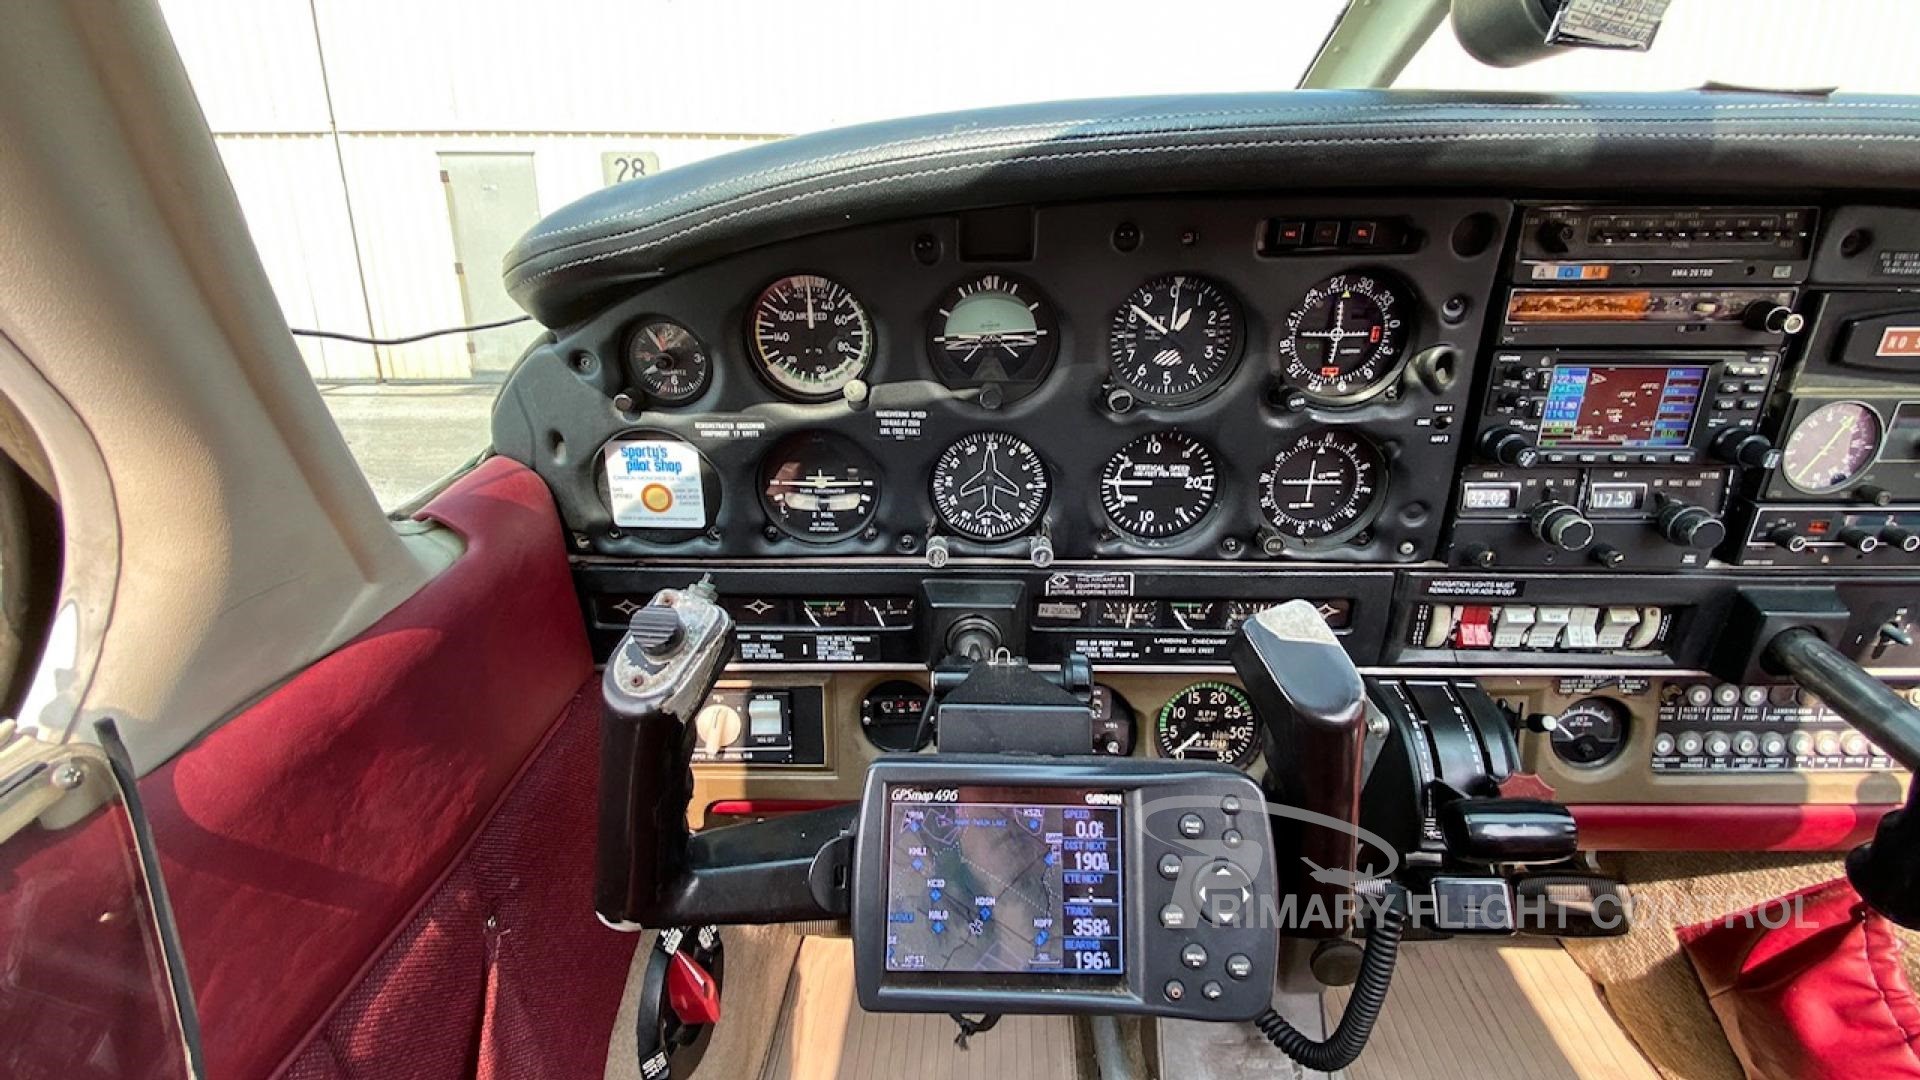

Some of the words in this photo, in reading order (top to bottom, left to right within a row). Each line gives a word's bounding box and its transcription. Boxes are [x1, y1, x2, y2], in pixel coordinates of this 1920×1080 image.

[1330, 275, 1347, 290] 27
[1358, 277, 1374, 291] 30
[820, 301, 835, 311] 40
[1143, 292, 1154, 307] 9
[779, 311, 795, 321] 160
[795, 311, 828, 321] AIREED
[834, 313, 849, 326] 60
[1128, 310, 1138, 324] 8
[1207, 310, 1218, 325] 2
[773, 331, 790, 343] 140
[1887, 335, 1908, 349] NO
[694, 352, 703, 364] 3
[1126, 349, 1136, 362] 7
[1204, 345, 1214, 360] 3
[1137, 363, 1147, 377] 6
[1187, 362, 1198, 376] 4
[670, 374, 679, 385] 6
[1162, 370, 1172, 385] 5
[620, 444, 668, 461] sporty's
[1145, 441, 1162, 455] 10
[626, 460, 651, 475] pilot
[654, 460, 683, 476] shop
[1134, 463, 1165, 472] VERTICAL
[1183, 476, 1203, 489] 20
[1139, 510, 1155, 523] 10
[1431, 580, 1471, 588] NAVIGATION
[1471, 581, 1495, 589] LIGHTS
[1496, 581, 1515, 589] MUST
[1153, 637, 1188, 645] LANDING
[1187, 691, 1201, 705] 15
[1209, 691, 1227, 705] 20
[1172, 706, 1187, 719] 10
[1197, 708, 1218, 717] RPM
[1223, 705, 1242, 719] 25
[1168, 724, 1179, 738] 5
[1174, 750, 1185, 761] 0
[1216, 749, 1234, 762] 35
[891, 787, 934, 803] GPSmap
[934, 789, 959, 801] 496
[1084, 793, 1122, 805] GARMIN
[1063, 808, 1090, 819] SPEED
[1075, 820, 1098, 839] 0.0
[1063, 840, 1083, 851] DIST
[1085, 841, 1108, 851] NEXT
[1074, 851, 1101, 871] 190
[1163, 865, 1180, 873] QUIT
[1080, 874, 1104, 884] NEXT
[1064, 905, 1093, 916] TRACK
[1072, 917, 1102, 936] 358
[1064, 940, 1101, 951] BEARING
[1074, 951, 1104, 970] 196
